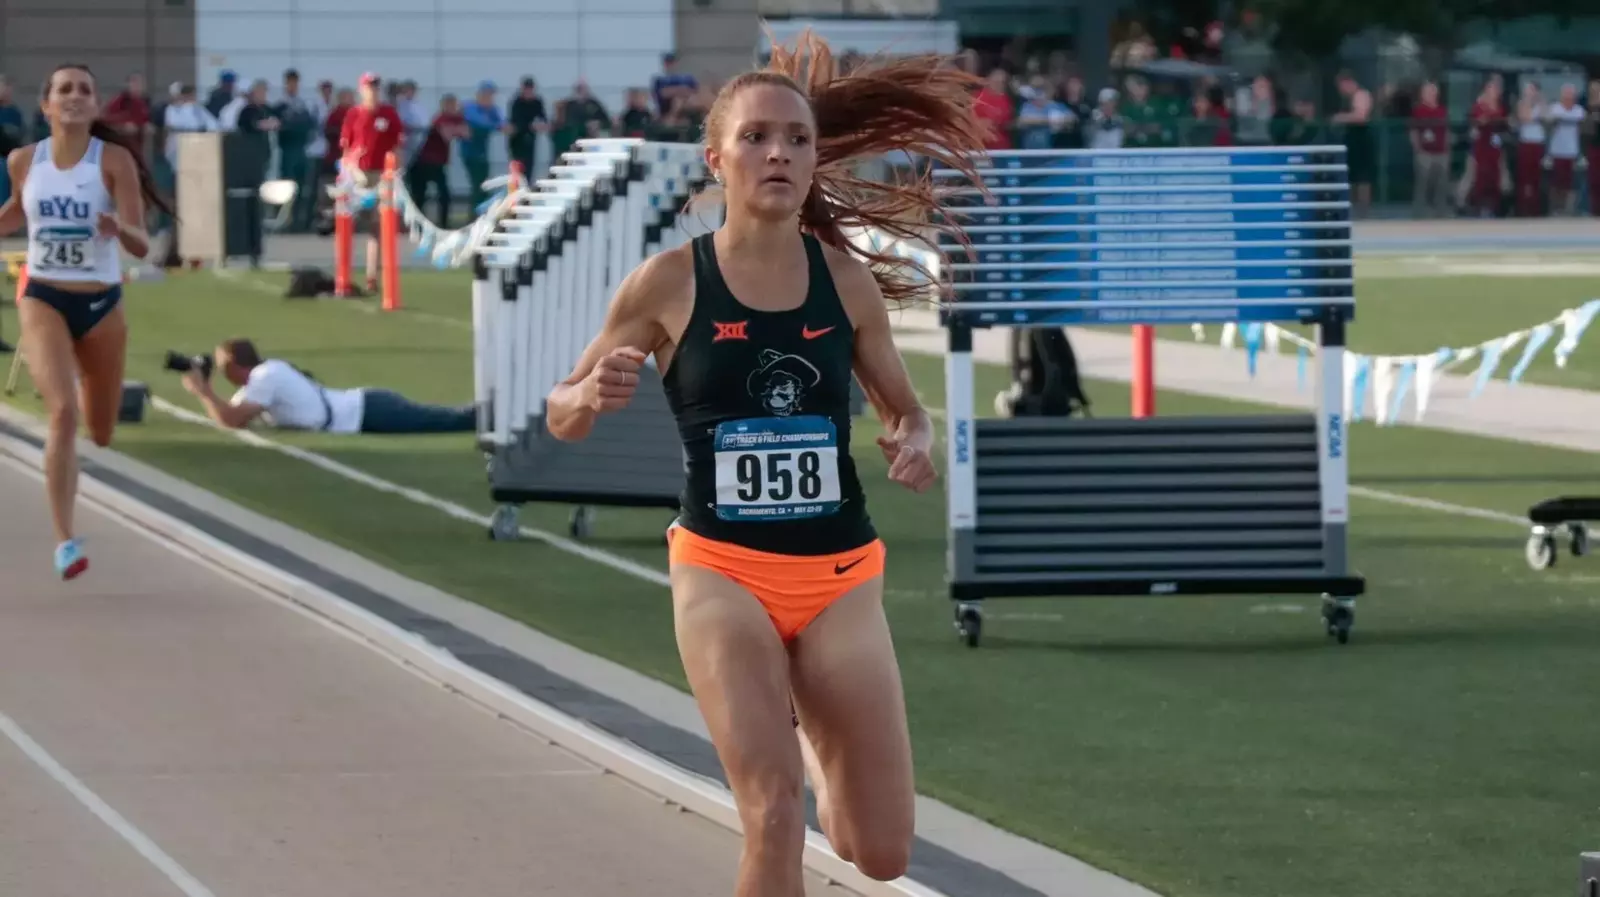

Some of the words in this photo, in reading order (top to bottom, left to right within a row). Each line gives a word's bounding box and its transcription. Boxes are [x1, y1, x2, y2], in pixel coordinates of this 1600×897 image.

[39, 195, 89, 219] BYU
[41, 241, 83, 264] 245
[736, 435, 757, 444] TRACK
[764, 434, 780, 443] FIELD
[736, 451, 821, 502] 958
